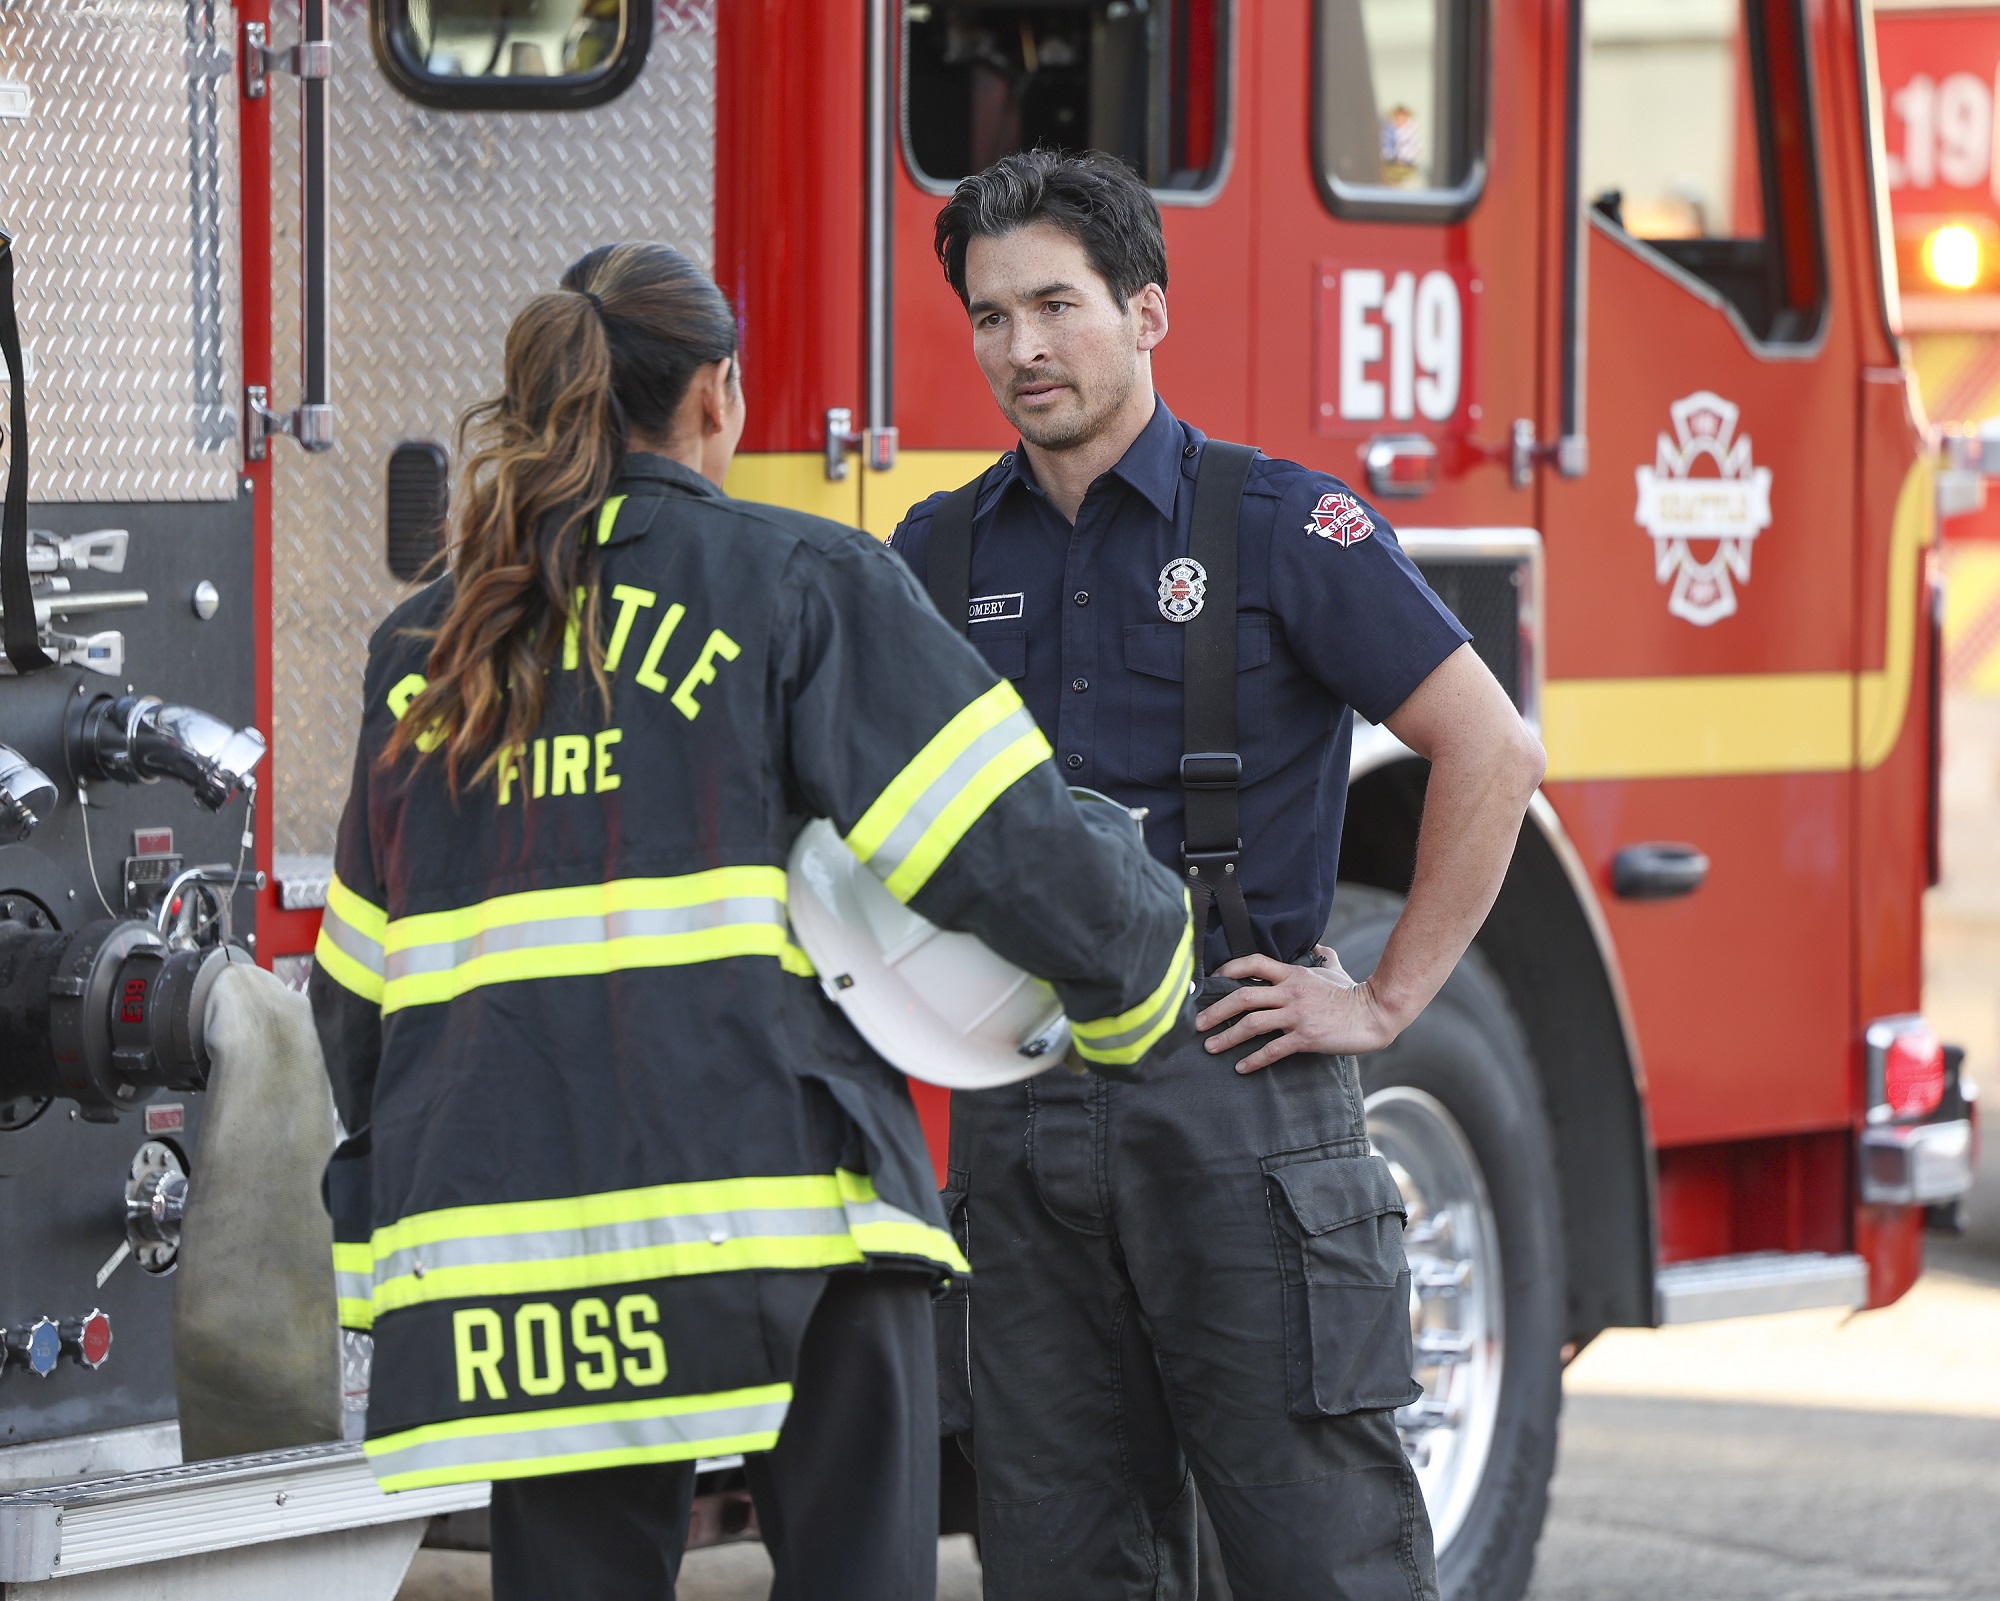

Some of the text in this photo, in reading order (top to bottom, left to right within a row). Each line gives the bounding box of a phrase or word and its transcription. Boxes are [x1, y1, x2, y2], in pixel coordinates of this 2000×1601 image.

[1339, 268, 1462, 422] E19
[968, 600, 1006, 617] OMERY
[386, 583, 742, 753] STTLE
[497, 727, 623, 806] FIRE
[121, 978, 147, 1023] E19
[452, 1293, 669, 1402] ROSS
